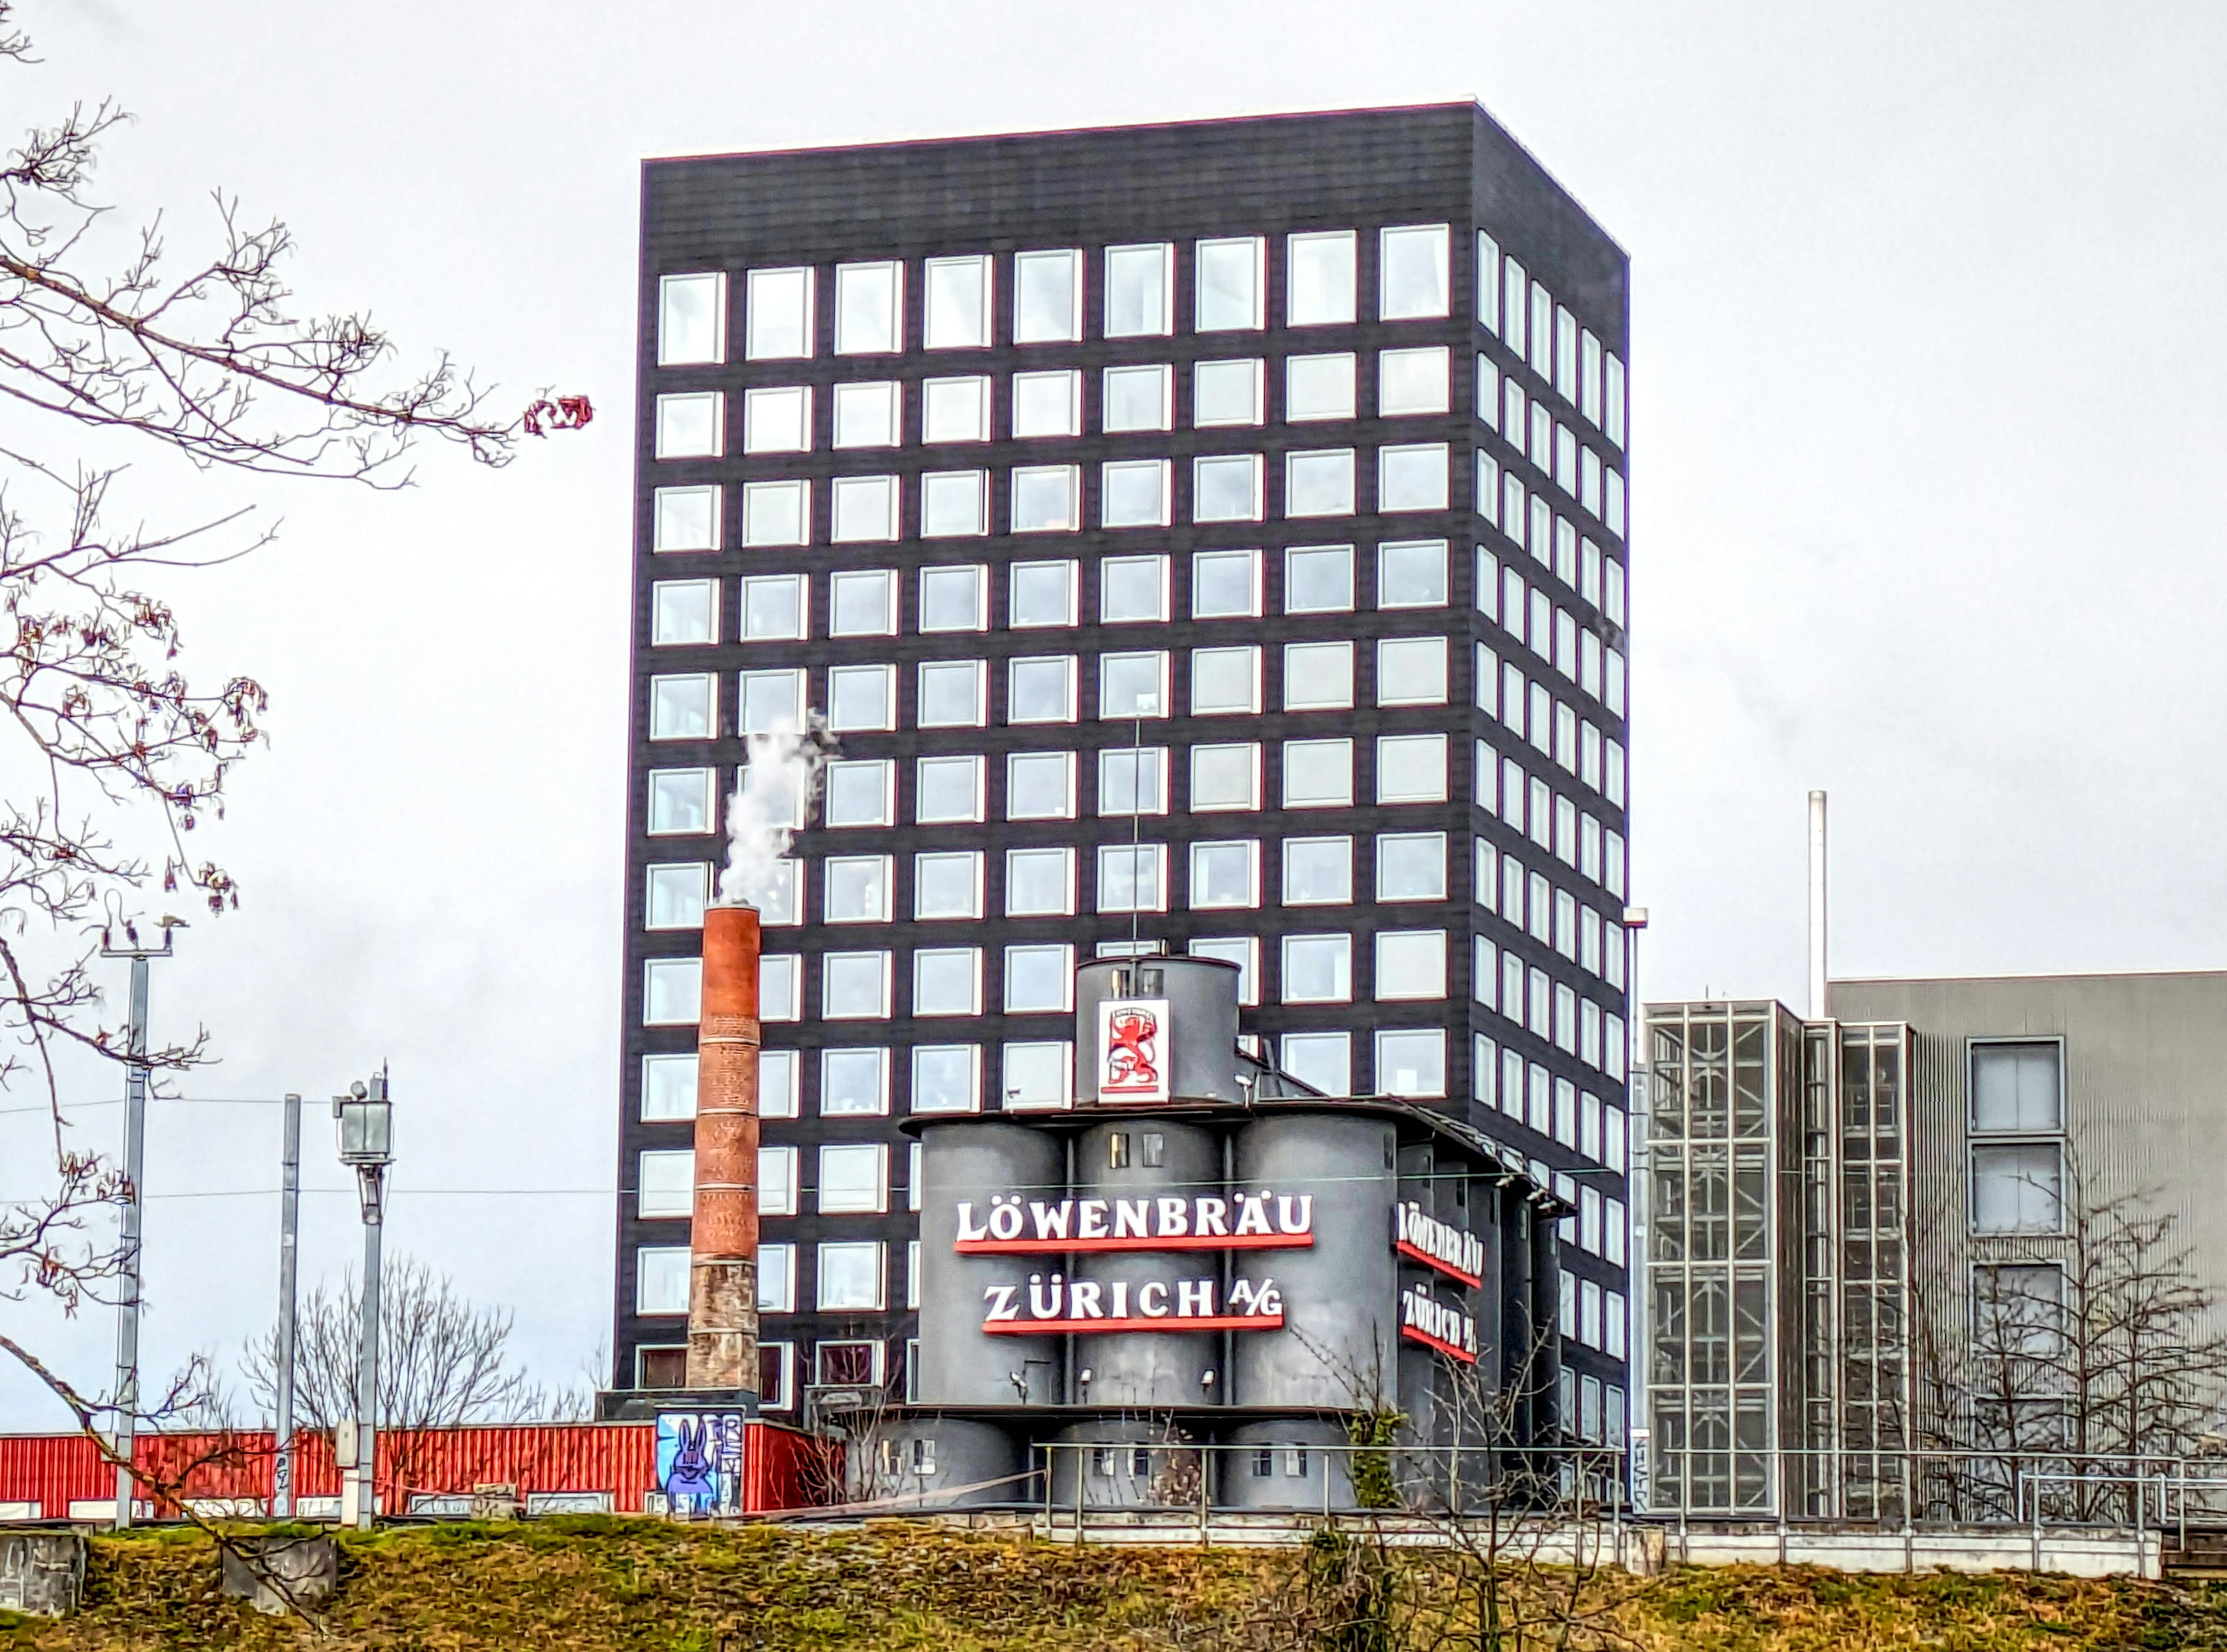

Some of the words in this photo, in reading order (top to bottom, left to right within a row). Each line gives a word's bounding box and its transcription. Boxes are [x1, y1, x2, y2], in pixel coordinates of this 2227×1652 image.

[956, 1190, 1313, 1240] LÖWENBRÄU
[983, 1273, 1214, 1320] ZÜRICH
[1228, 1278, 1282, 1316] A/G
